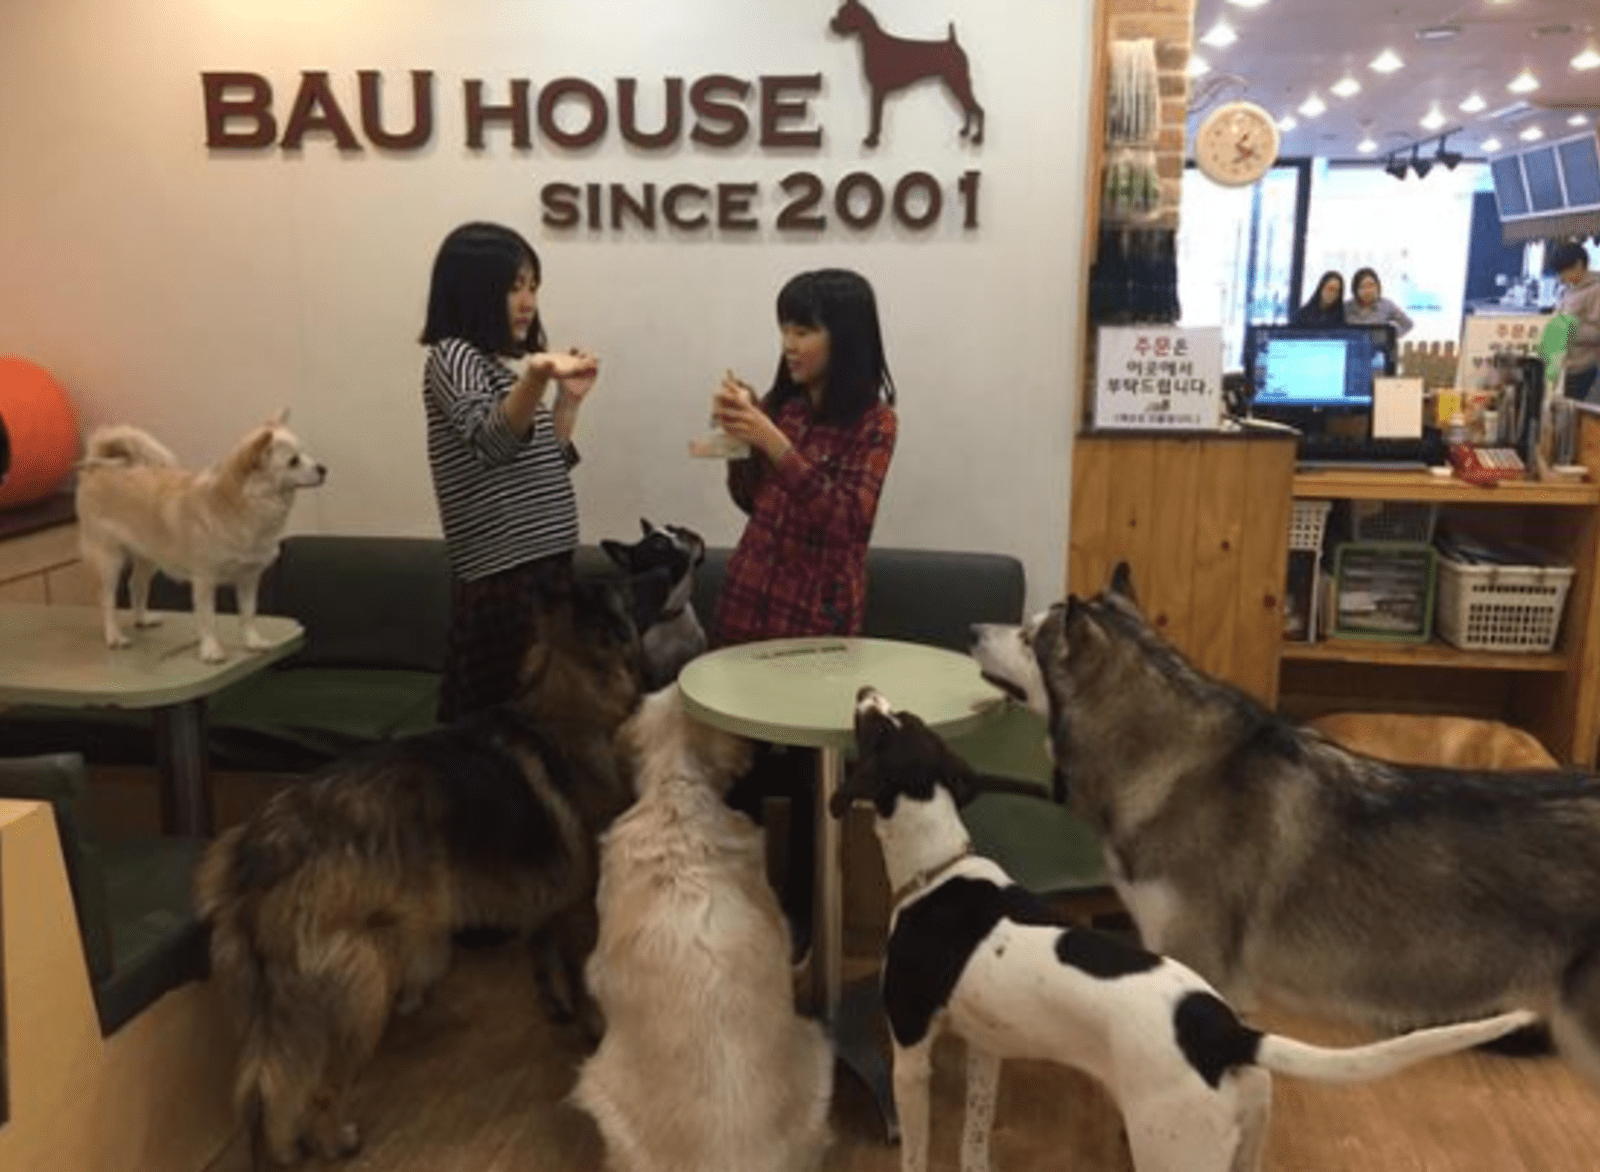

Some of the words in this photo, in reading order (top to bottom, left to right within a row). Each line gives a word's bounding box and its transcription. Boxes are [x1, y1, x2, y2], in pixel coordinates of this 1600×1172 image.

[200, 70, 434, 150] BAU
[463, 73, 823, 150] HOUSE
[539, 182, 758, 231] SINCE
[775, 171, 981, 231] 2001
[1134, 335, 1189, 357] 주문은
[1126, 360, 1193, 377] 이곳에서
